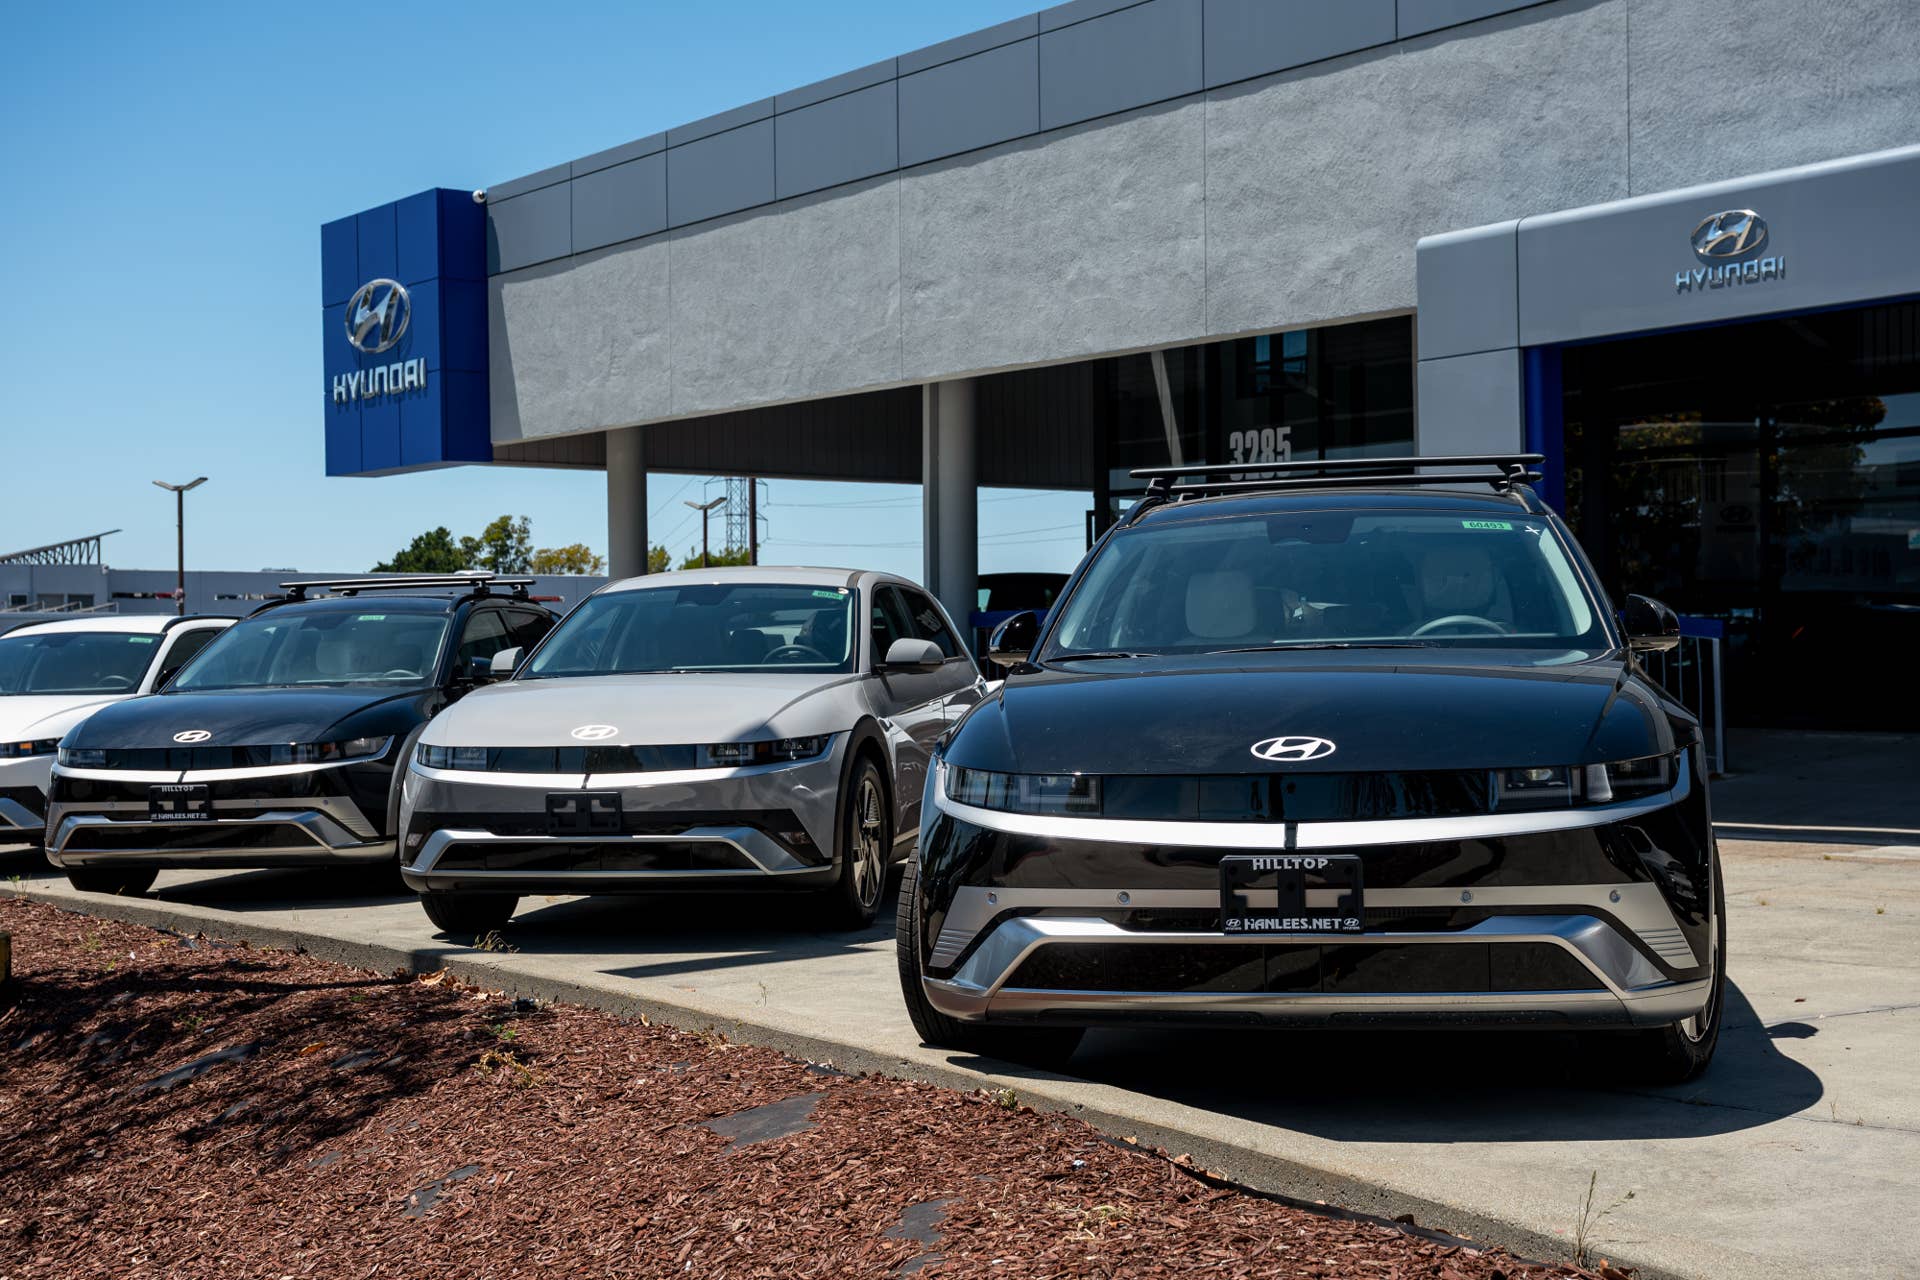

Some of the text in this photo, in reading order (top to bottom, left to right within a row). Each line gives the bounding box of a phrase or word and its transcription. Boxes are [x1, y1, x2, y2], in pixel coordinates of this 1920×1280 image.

[1675, 256, 1785, 290] HYUNDAI
[333, 357, 425, 402] HYUNDAI
[1229, 426, 1291, 481] 3285
[1252, 858, 1328, 870] HILLTOP
[1244, 918, 1342, 930] HANLEES.NET
